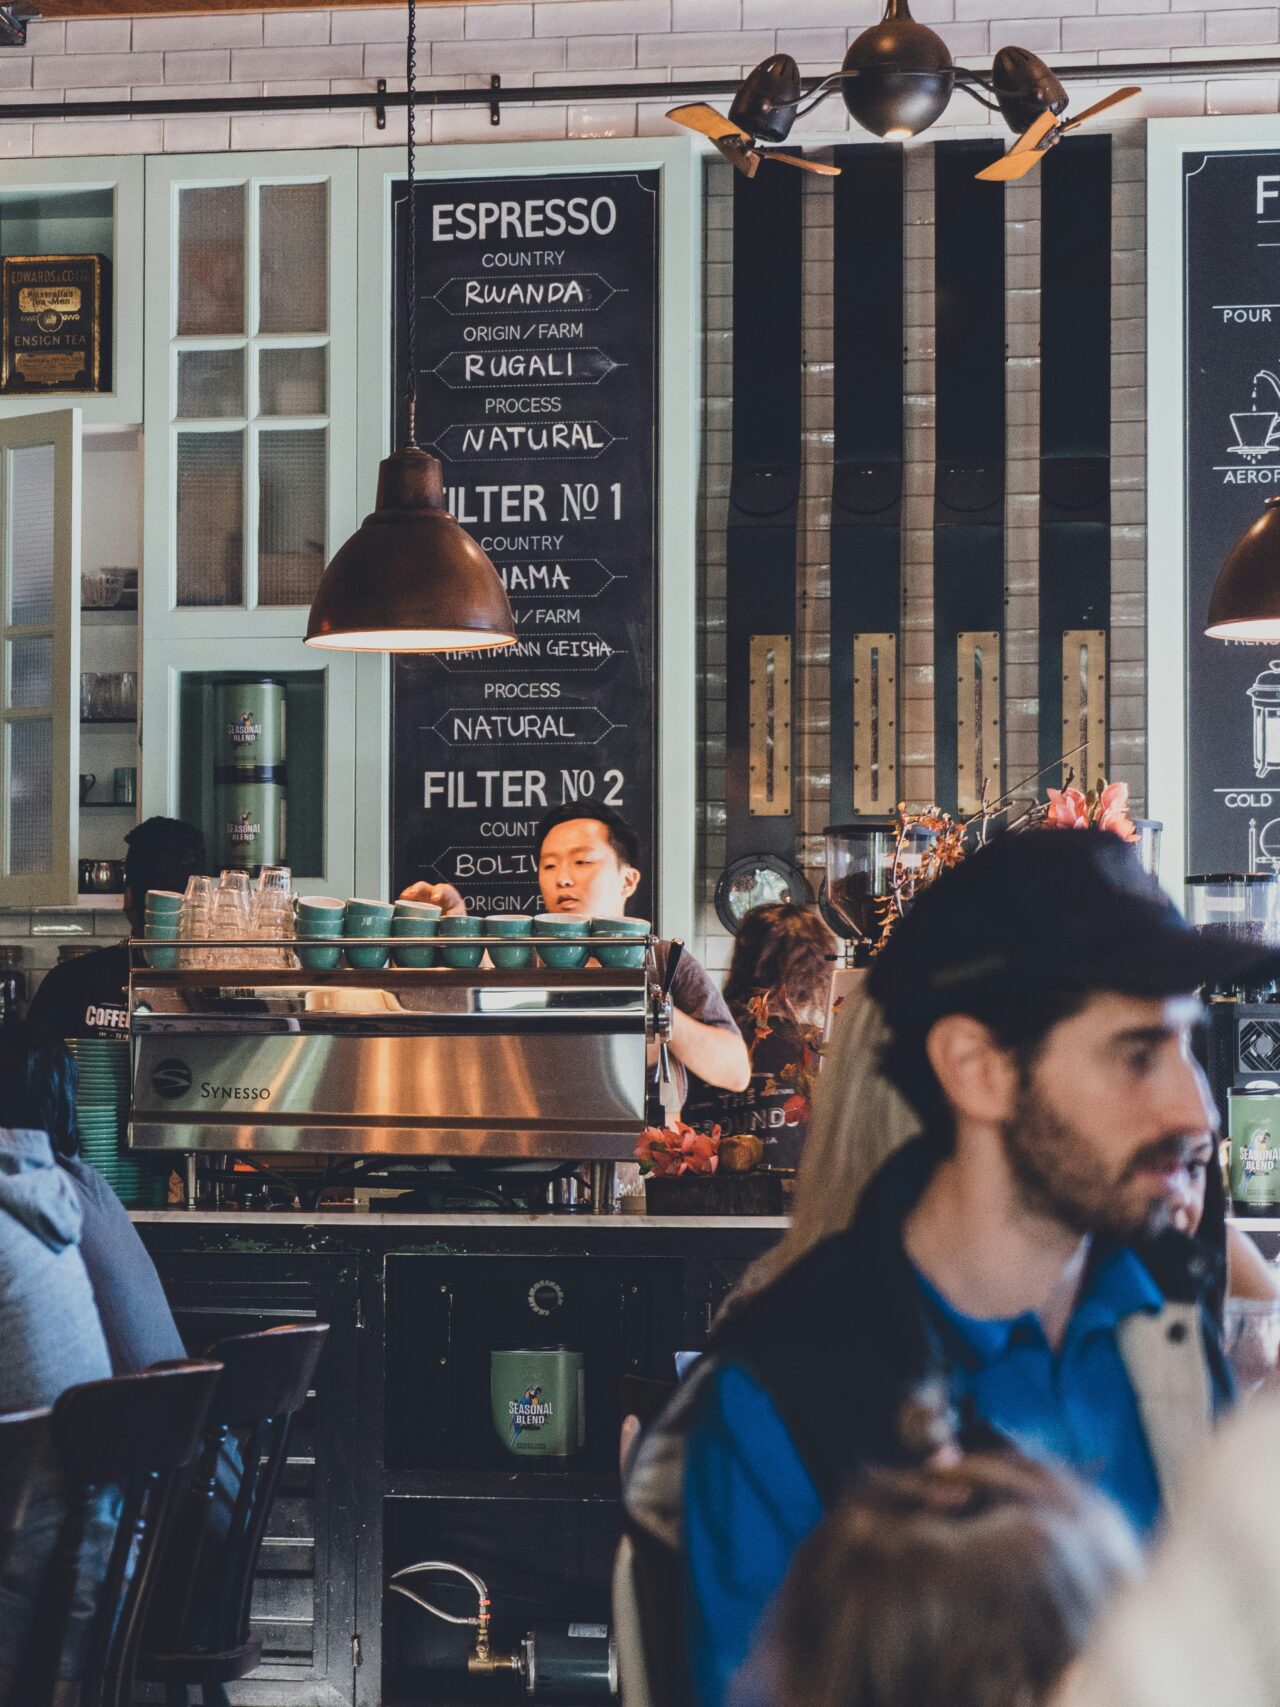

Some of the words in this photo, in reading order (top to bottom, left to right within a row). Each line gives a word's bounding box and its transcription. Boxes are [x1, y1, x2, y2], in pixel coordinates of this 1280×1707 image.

[432, 197, 616, 241] ESPRESSO
[482, 250, 565, 267] COUNTRY
[465, 280, 583, 307] RWANDA
[1223, 309, 1272, 322] POUR
[15, 335, 60, 346] ENSIGN
[65, 334, 86, 345] TEA
[465, 352, 572, 381] RUGALI
[485, 397, 561, 413] PROCESS
[462, 424, 604, 452] NATURAL
[442, 484, 547, 523] ILTER
[610, 482, 621, 520] 1
[481, 535, 564, 551] COUNTRY
[500, 564, 570, 590] NAMA
[547, 638, 612, 657] GEISHA
[484, 683, 561, 698] PROCESS
[228, 724, 262, 734] SEASONAL
[454, 715, 575, 740] NATURAL
[424, 770, 547, 808] FILTER
[603, 769, 624, 806] 2
[1225, 793, 1272, 807] COLD
[227, 823, 261, 833] SEASONAL
[480, 822, 539, 837] COUNT
[232, 833, 254, 841] BLEND
[454, 854, 538, 877] BOLIV
[464, 895, 545, 911] ORIGIN/F
[1246, 1161, 1274, 1170] BLEND
[509, 1401, 553, 1415] SEASONAL
[516, 1415, 545, 1425] BLEND
